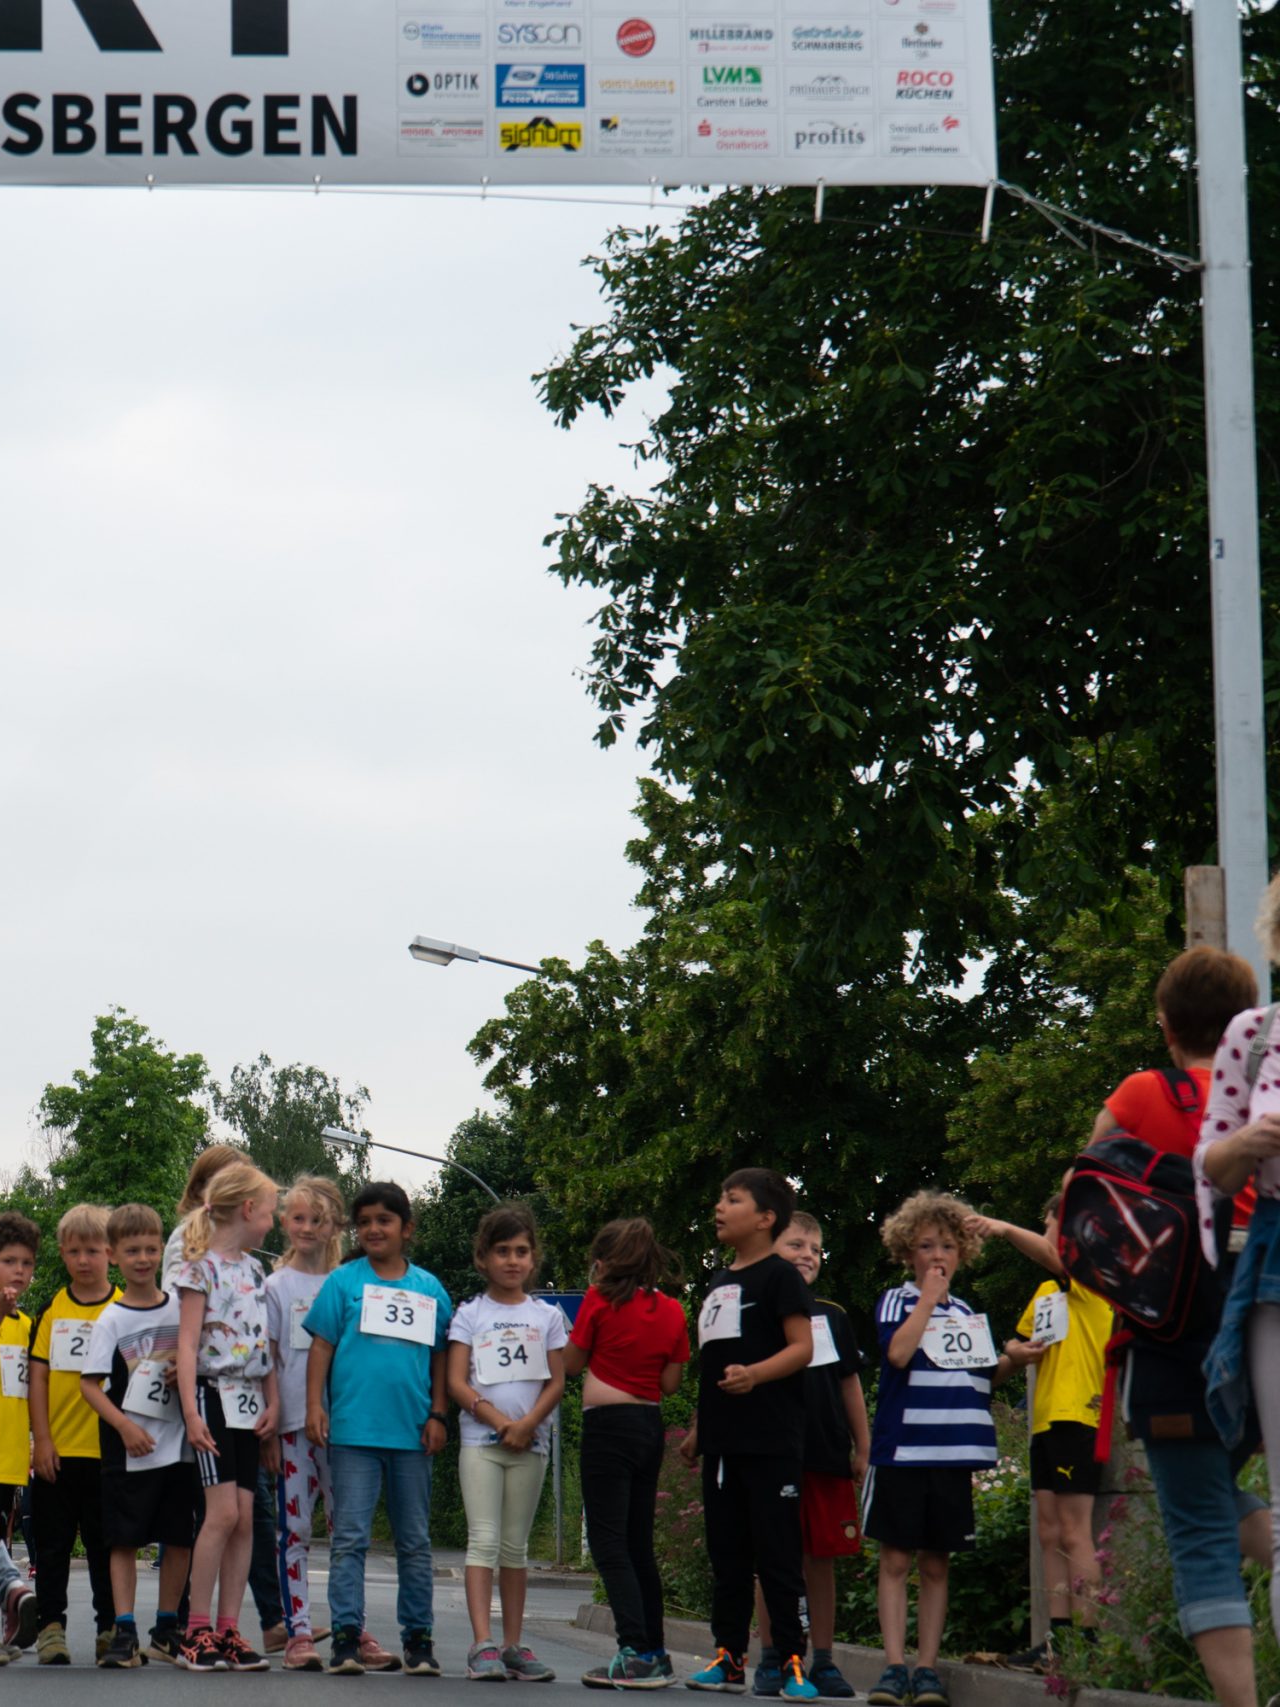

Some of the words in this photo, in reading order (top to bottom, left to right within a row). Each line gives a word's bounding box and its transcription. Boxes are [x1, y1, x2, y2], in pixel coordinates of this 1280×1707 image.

[689, 29, 774, 41] HILLEBRAND
[791, 40, 864, 51] SCHWARBERG
[433, 73, 480, 91] OPTIK
[703, 67, 743, 85] LVM
[896, 71, 955, 87] ROCO
[895, 87, 954, 100] KÜCHEN
[795, 126, 866, 150] profits
[384, 1304, 415, 1326] 33
[1035, 1310, 1053, 1333] 21
[941, 1331, 973, 1354] 20
[497, 1343, 529, 1367] 34
[237, 1393, 259, 1416] 26
